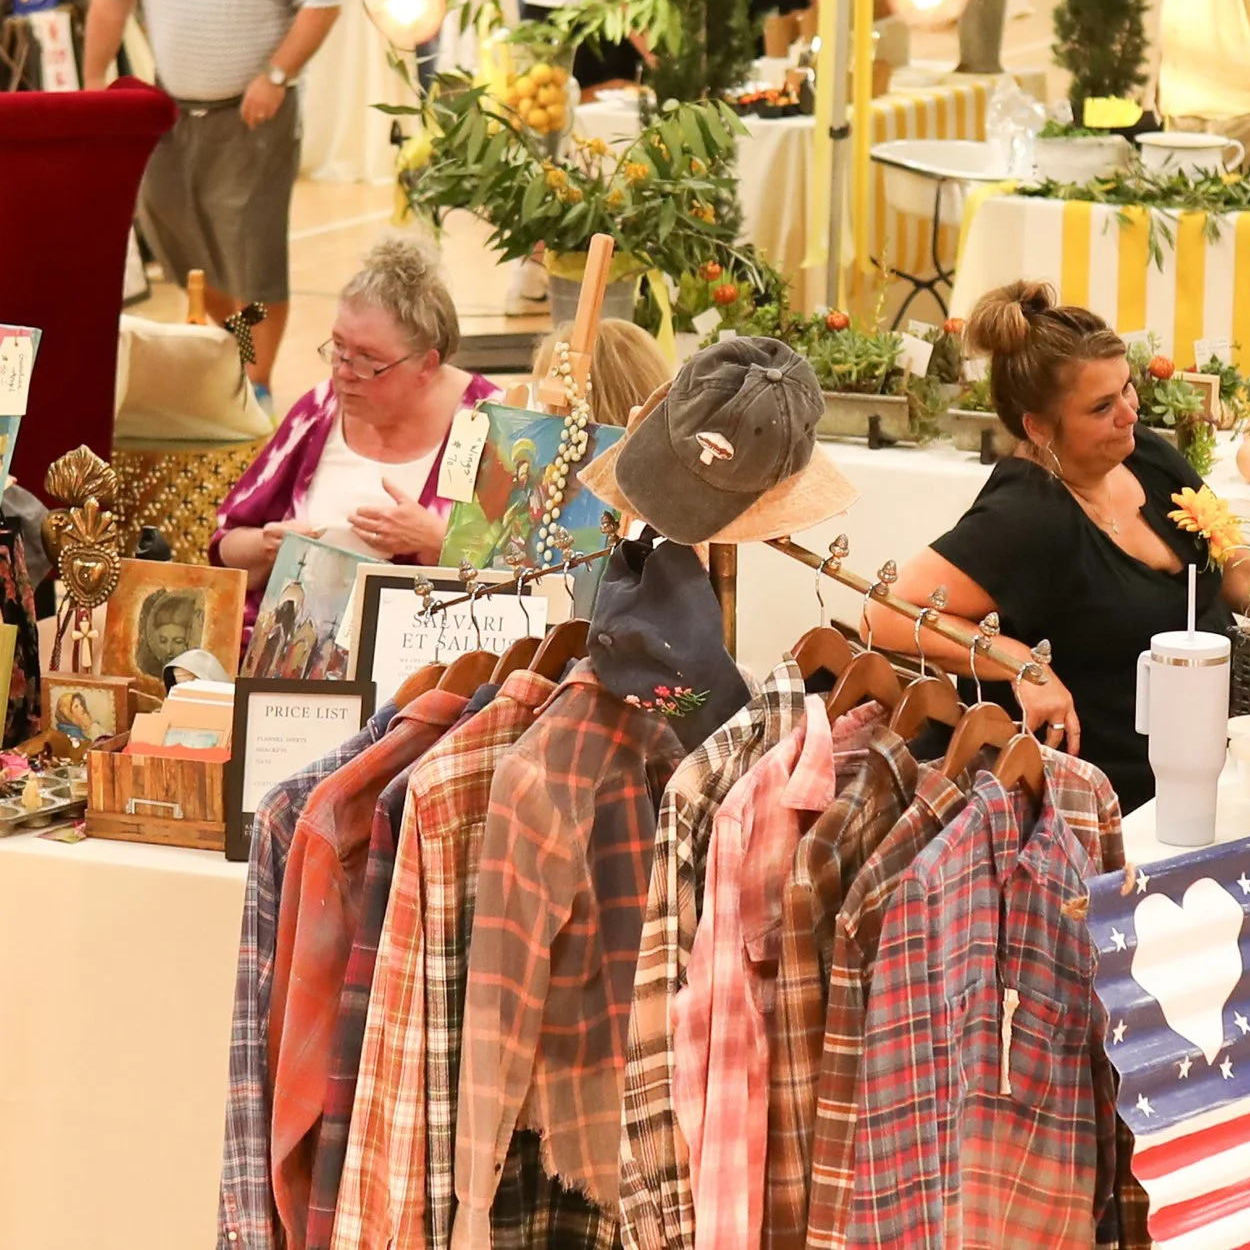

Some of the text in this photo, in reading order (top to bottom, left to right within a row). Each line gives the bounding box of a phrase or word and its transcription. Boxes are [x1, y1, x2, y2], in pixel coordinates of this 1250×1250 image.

[412, 612, 504, 632] SALVARI
[402, 633, 428, 649] ET
[265, 705, 348, 720] PRICE LIST
